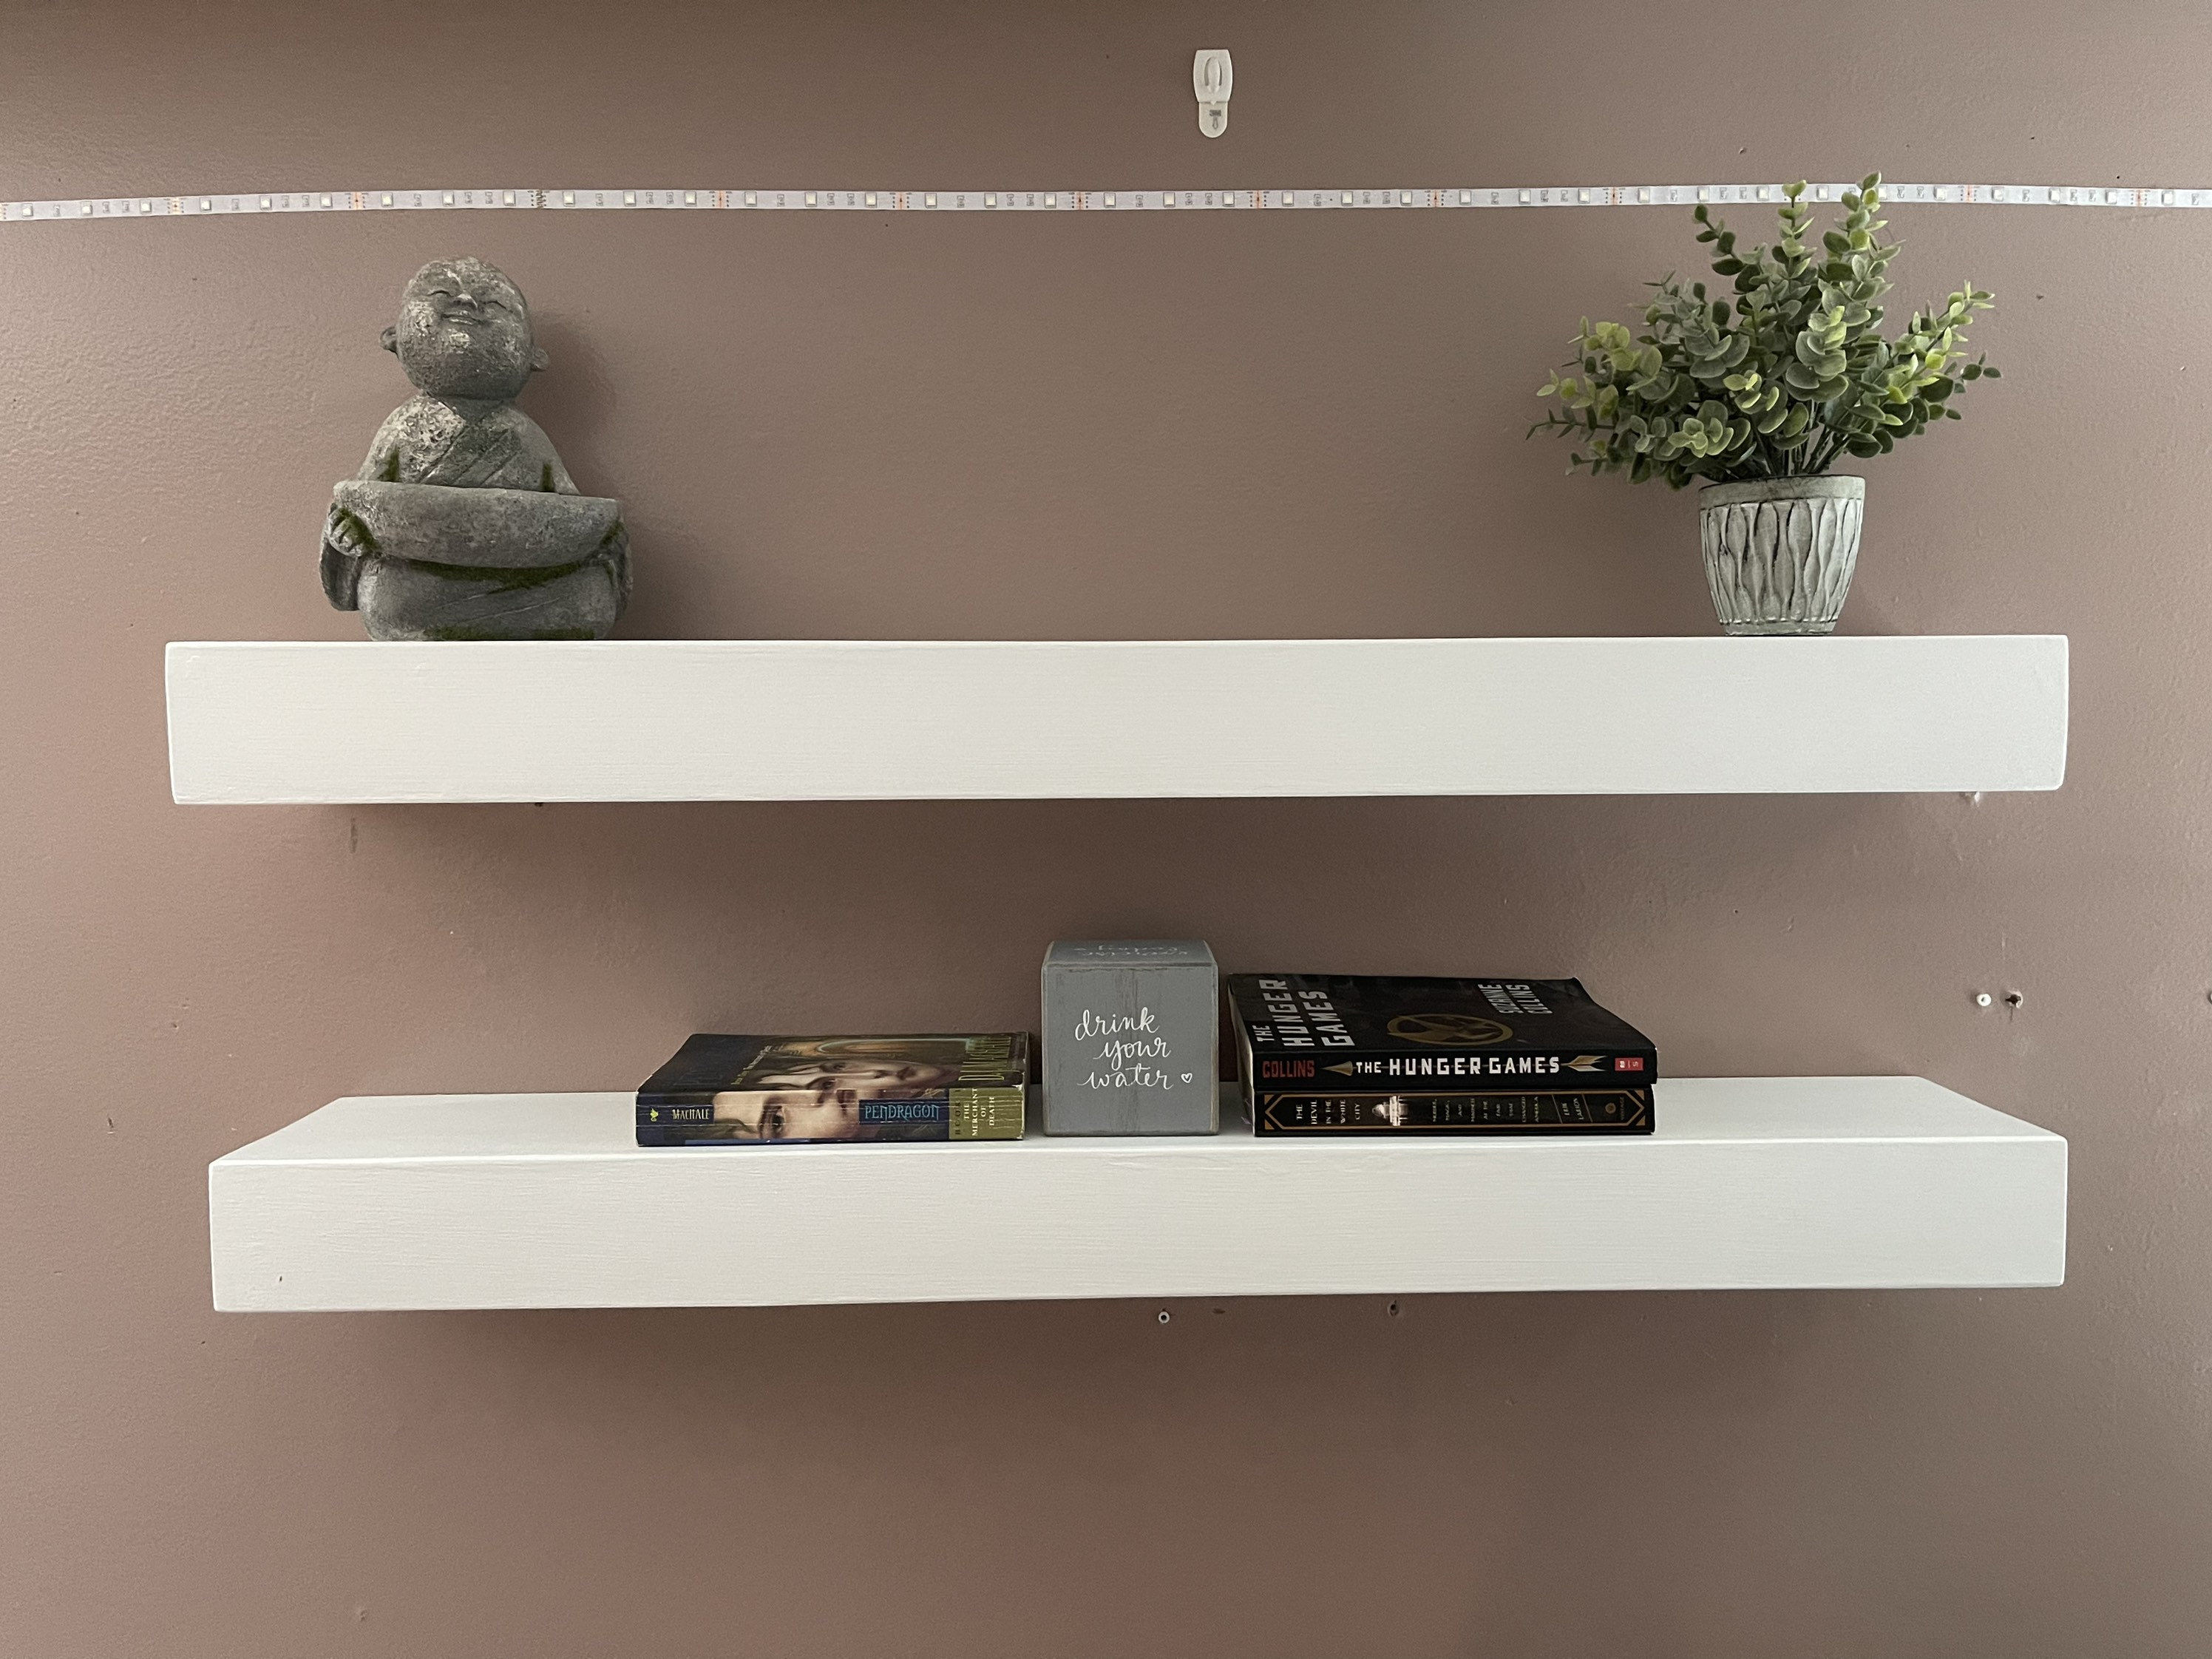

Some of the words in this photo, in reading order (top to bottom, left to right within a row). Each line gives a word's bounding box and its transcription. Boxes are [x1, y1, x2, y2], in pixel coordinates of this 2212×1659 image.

[1258, 979, 1315, 1046] HUNGER
[1477, 983, 1524, 1014] SUZANNE
[1505, 984, 1553, 1014] COLLINS
[1075, 1007, 1159, 1041] drink
[1297, 991, 1356, 1046] GAMES
[1252, 1025, 1275, 1042] THE
[1093, 1037, 1171, 1071] your
[1356, 1062, 1382, 1073] THE
[1389, 1057, 1481, 1076] HUNGER
[1488, 1056, 1560, 1074] GAMES
[1076, 1062, 1174, 1090] water
[1262, 1059, 1315, 1079] COLLINS
[864, 1105, 940, 1121] PENDRAGON
[980, 1105, 986, 1118] OF
[1326, 1116, 1331, 1124] IN
